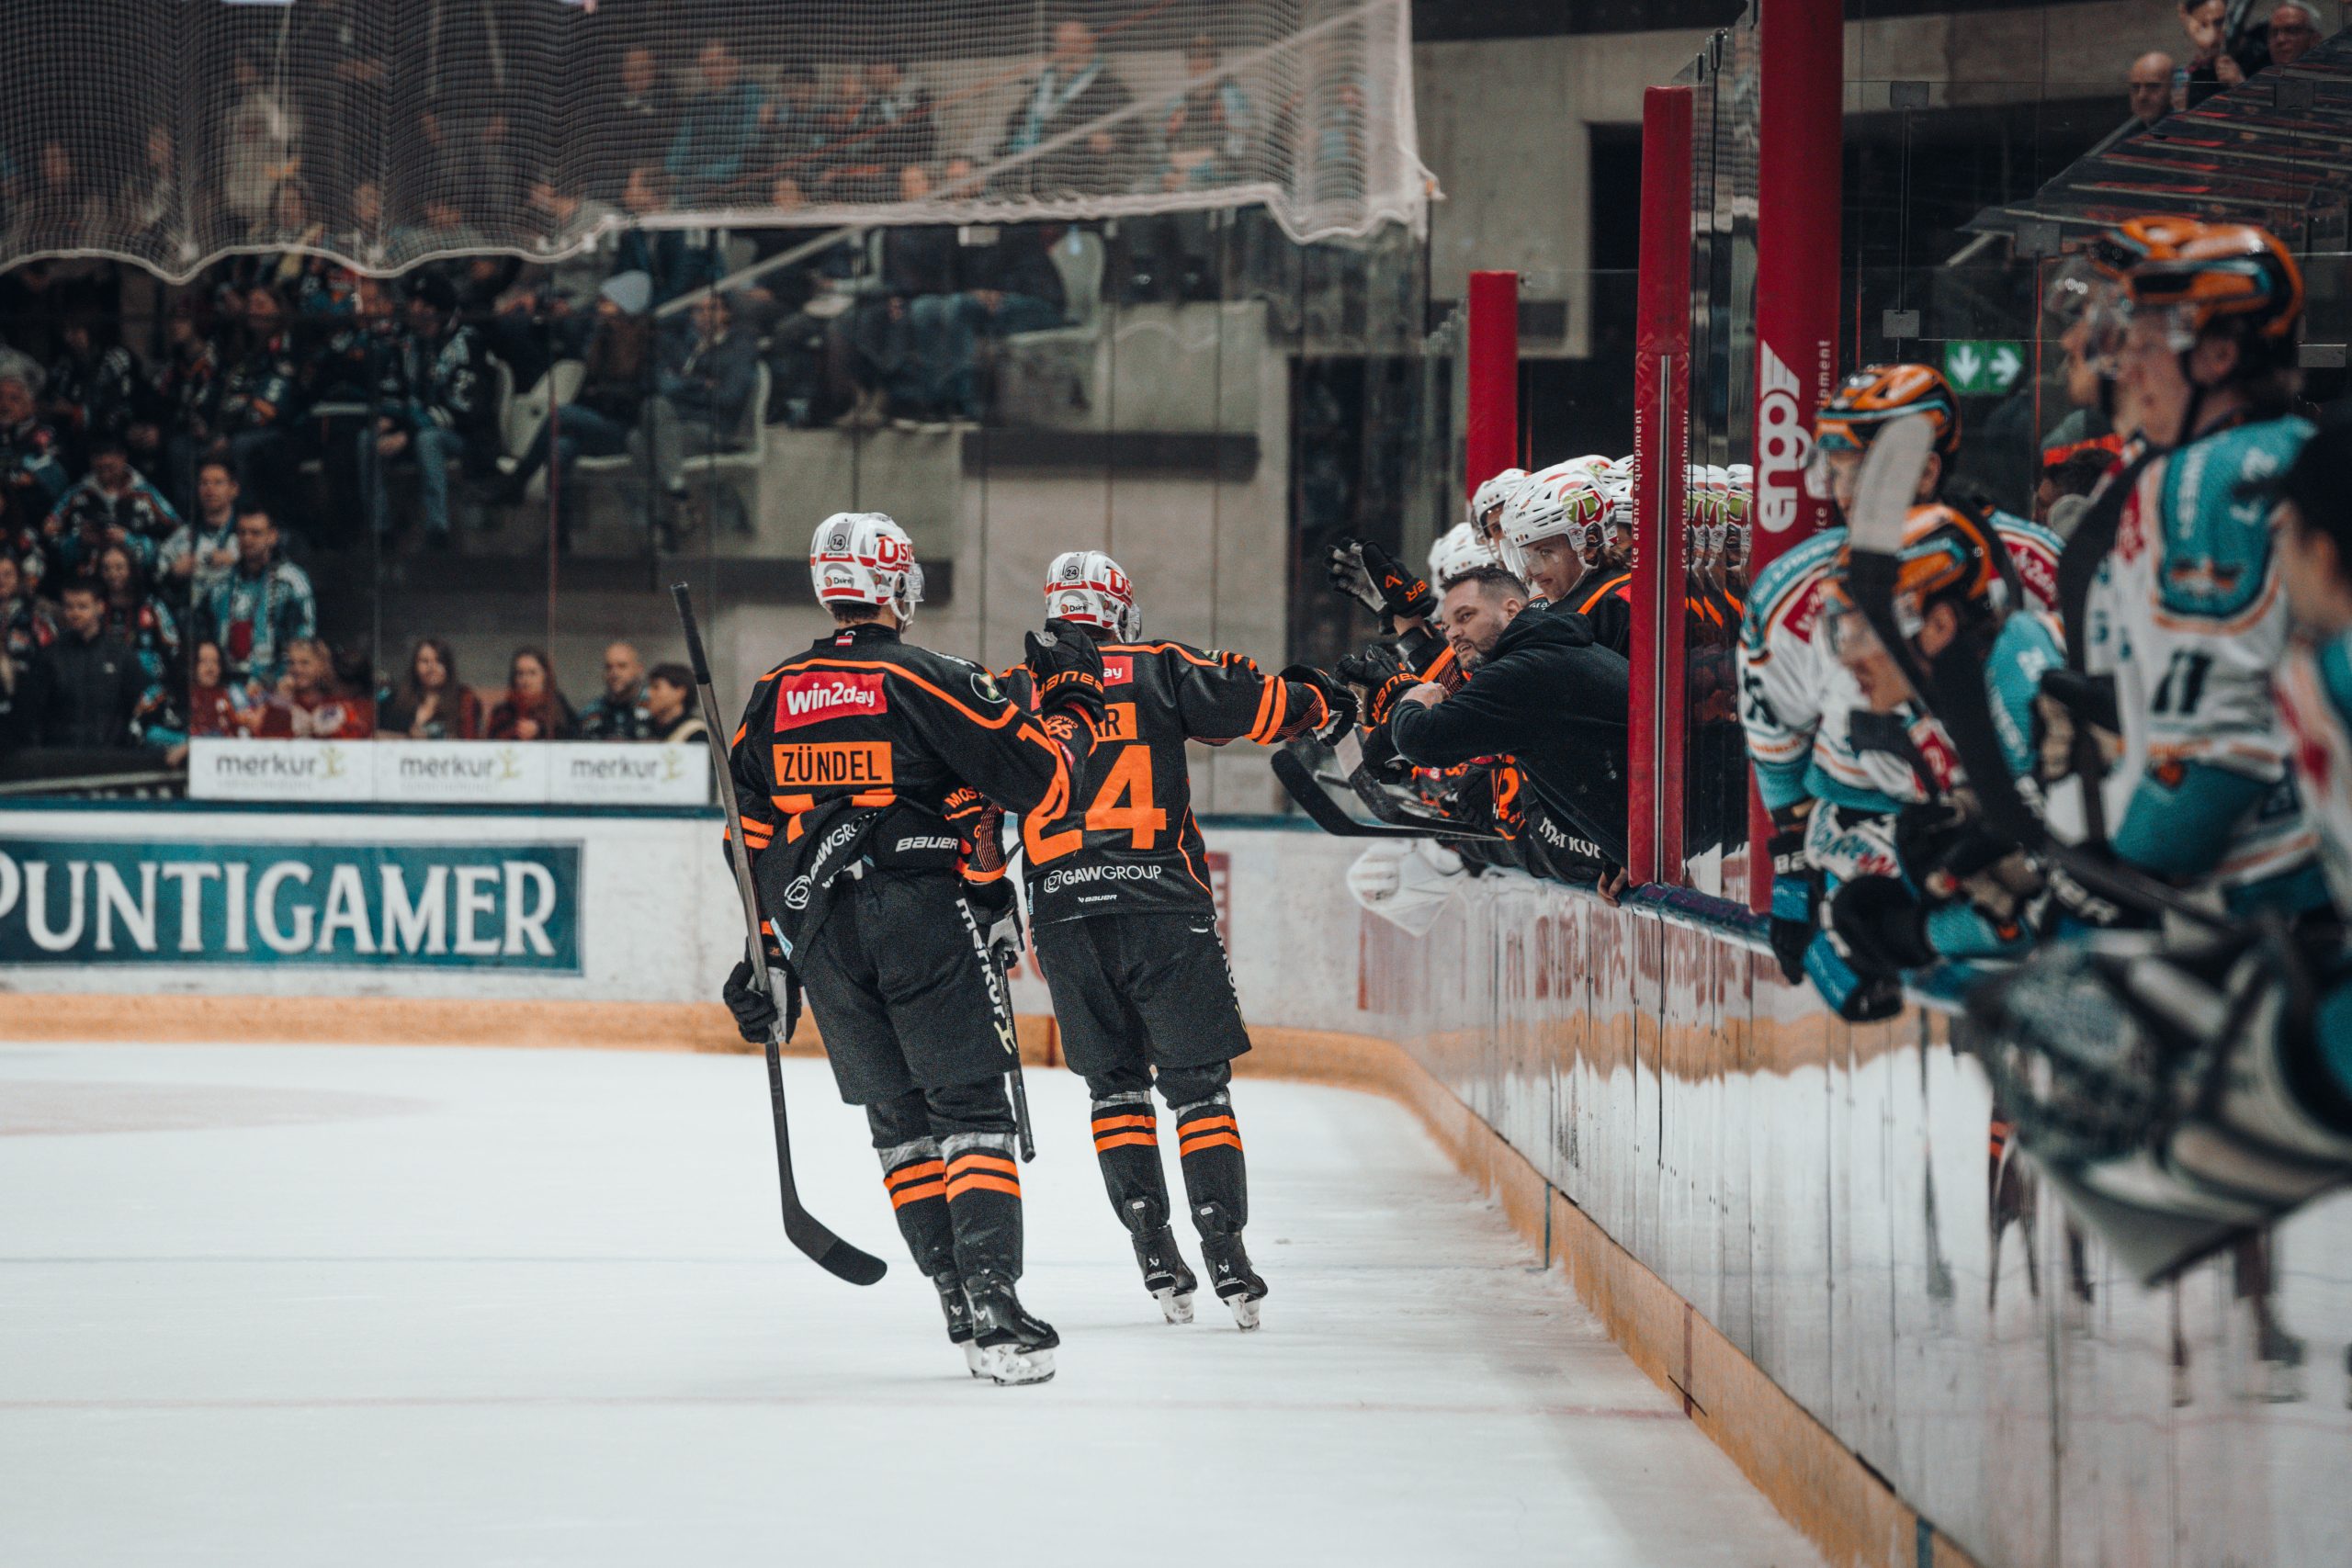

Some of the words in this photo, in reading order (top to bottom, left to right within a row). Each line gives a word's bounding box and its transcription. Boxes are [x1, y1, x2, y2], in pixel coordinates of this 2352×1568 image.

[1634, 409, 1644, 491] equipment
[1758, 391, 1810, 533] engo
[1633, 499, 1641, 541] arena
[832, 537, 843, 547] 14
[1631, 547, 1639, 569] ice
[216, 752, 316, 775] merkur
[400, 754, 493, 778] merkur
[571, 755, 658, 779] merkur
[783, 745, 882, 783] ZÜNDEL
[895, 837, 959, 852] BAUER
[1062, 865, 1162, 886] GAWGROUP
[1084, 894, 1118, 903] BAUER
